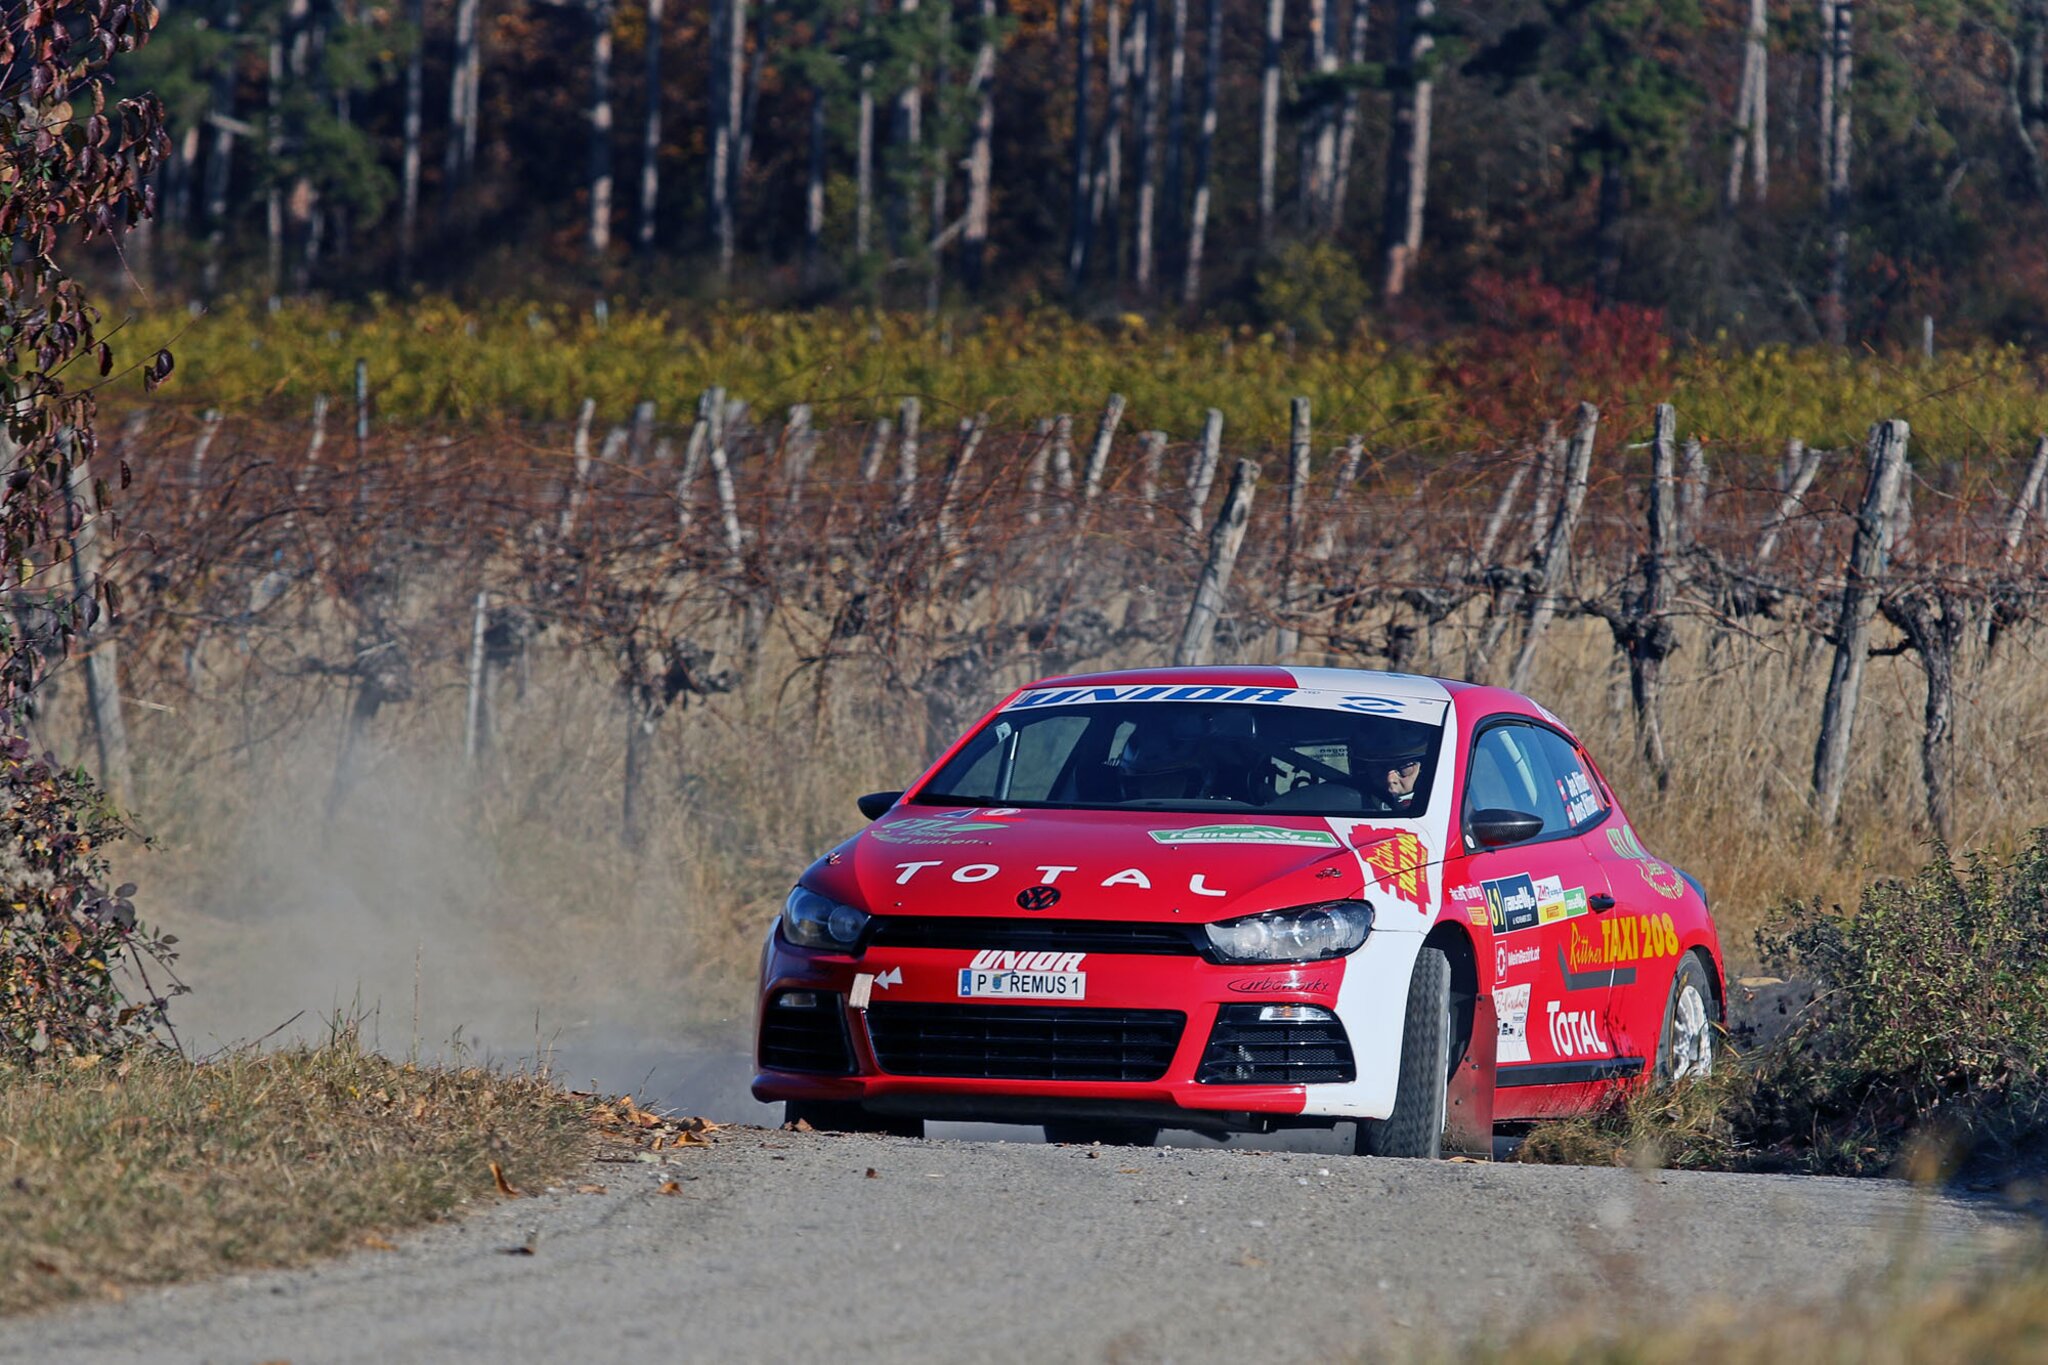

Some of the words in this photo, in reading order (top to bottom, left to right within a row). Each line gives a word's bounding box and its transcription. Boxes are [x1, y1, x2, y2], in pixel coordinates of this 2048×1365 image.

[1009, 686, 1297, 709] UNIOR
[895, 860, 1227, 897] TOTAL
[1487, 888, 1504, 927] 61
[1601, 916, 1639, 963] TAXI
[1640, 912, 1679, 958] 208
[969, 949, 1087, 973] UNIOR
[977, 974, 987, 992] P
[1010, 975, 1067, 994] REMUS
[1071, 977, 1079, 994] 1
[1546, 1000, 1608, 1057] TOTAL
